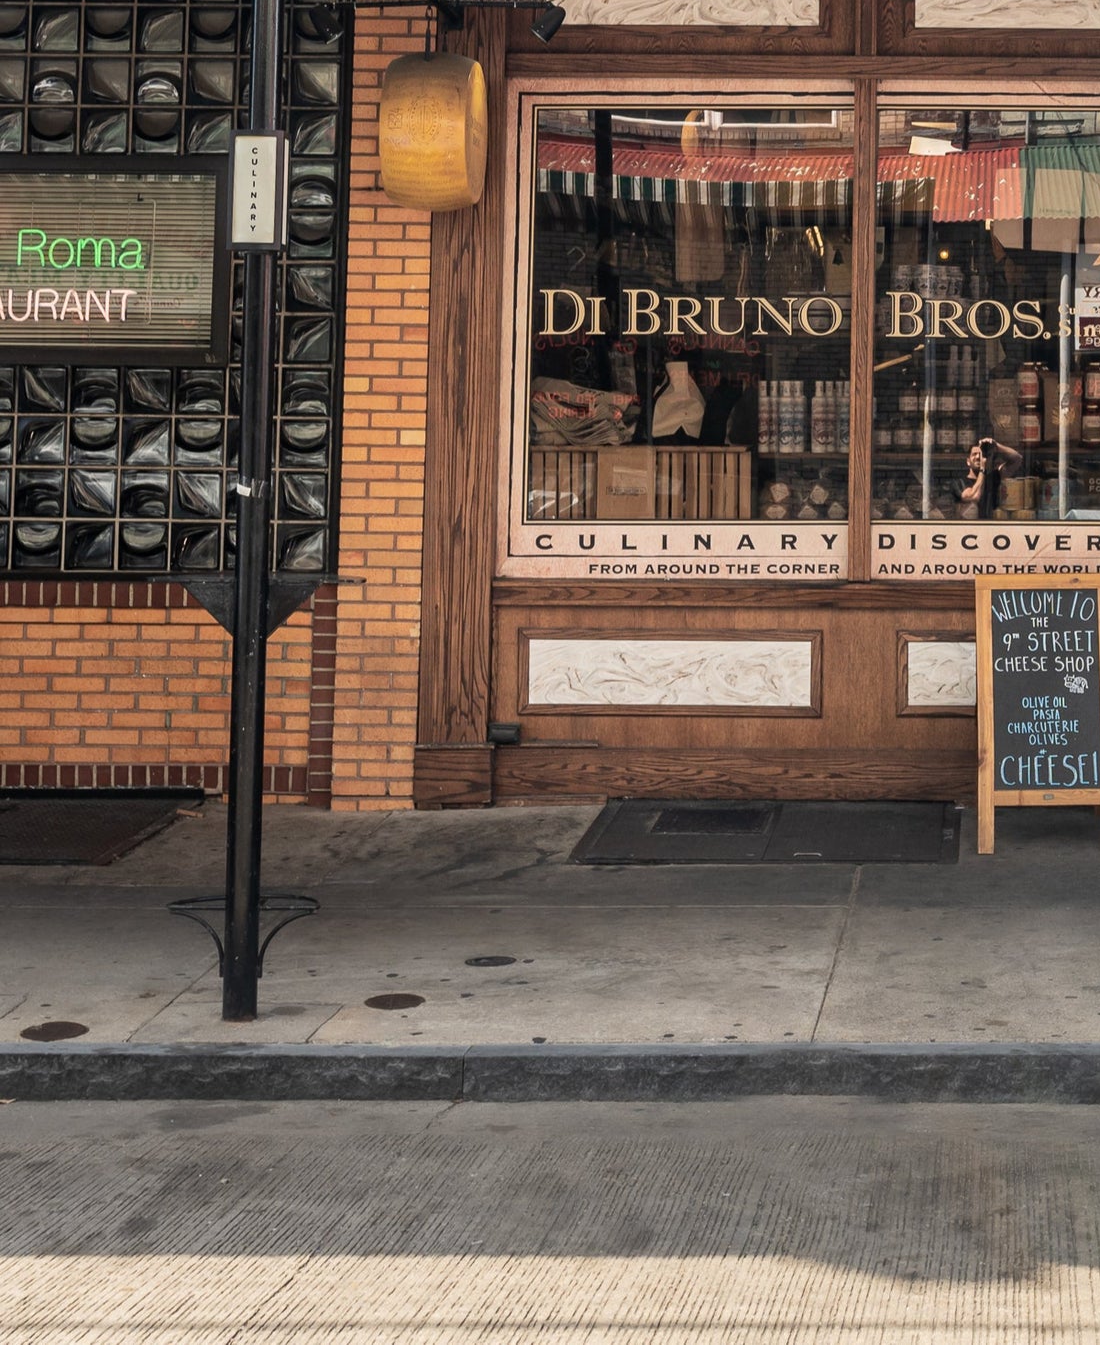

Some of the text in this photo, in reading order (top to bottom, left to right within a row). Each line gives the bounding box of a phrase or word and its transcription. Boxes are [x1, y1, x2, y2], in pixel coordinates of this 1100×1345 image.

[250, 147, 258, 232] CULINARY
[17, 229, 145, 270] Roma
[535, 533, 839, 551] CULINARY
[588, 563, 637, 575] FROM
[644, 563, 720, 575] AROUND
[725, 563, 760, 575] THE
[766, 563, 840, 575] CORNER
[878, 564, 916, 575] AND
[921, 564, 997, 575] AROUND
[1002, 564, 1037, 574] THE
[991, 590, 1095, 623] WELCOME TO
[1030, 616, 1049, 628] THE
[1027, 630, 1095, 652] STREET
[994, 655, 1094, 672] CHEESE SHOP
[1021, 695, 1068, 709] OLIVE OIL
[1033, 709, 1060, 720] PASTA
[1007, 719, 1079, 734] CHARCUTERIE
[1028, 733, 1068, 746] OLIVES
[1000, 751, 1098, 787] CHEESE!
